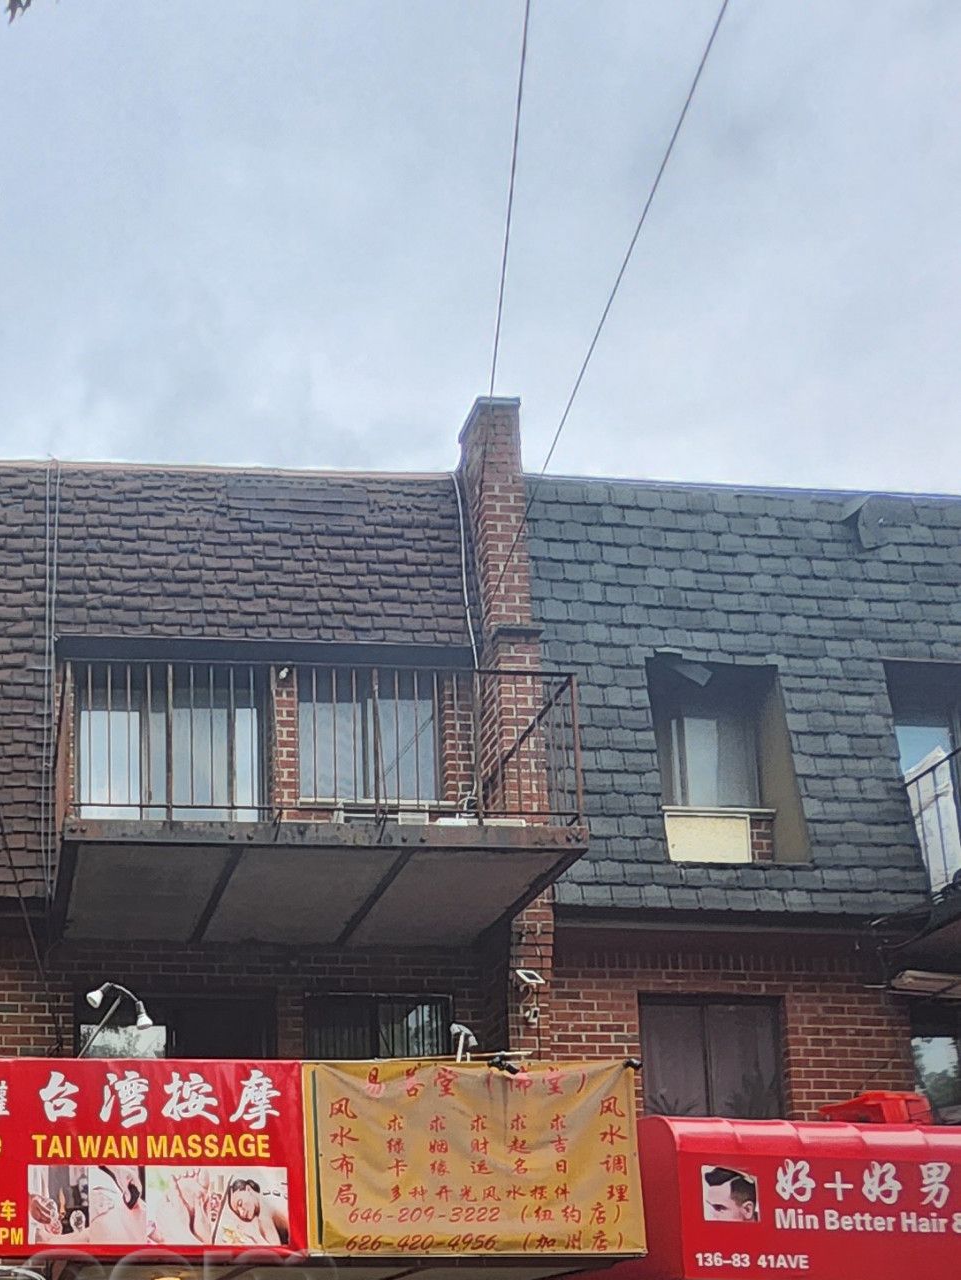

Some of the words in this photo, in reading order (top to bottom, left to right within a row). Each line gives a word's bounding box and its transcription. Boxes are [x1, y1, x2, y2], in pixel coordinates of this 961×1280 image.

[39, 1069, 281, 1129] 台湾按摩
[146, 1134, 270, 1158] MASSAGE
[348, 1206, 501, 1224] 646-209-3222
[775, 1209, 819, 1230] Min
[824, 1210, 895, 1232] Better
[901, 1211, 947, 1233] Hair
[345, 1233, 496, 1251] 626-420-4956
[695, 1252, 750, 1267] 136-83
[757, 1253, 809, 1269] 41AVE
